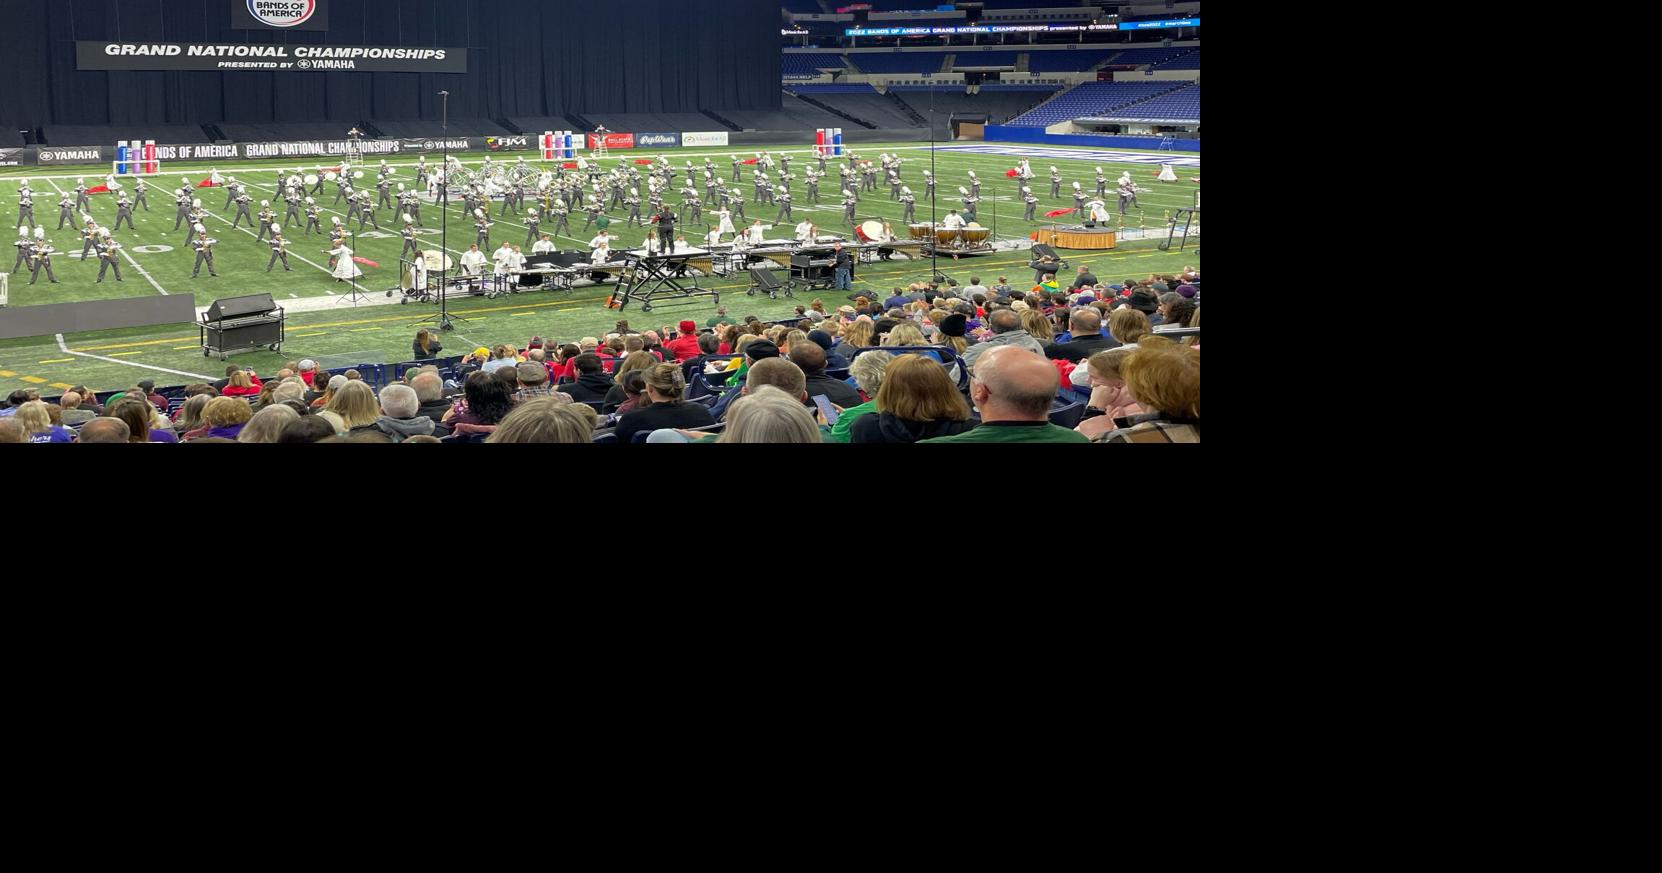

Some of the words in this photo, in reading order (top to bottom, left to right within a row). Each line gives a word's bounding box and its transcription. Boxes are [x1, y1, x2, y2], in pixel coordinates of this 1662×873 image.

[256, 2, 288, 10] BANDS
[260, 9, 302, 17] AMERICA
[105, 44, 181, 57] GRAND
[187, 45, 288, 58] NATIONAL
[294, 46, 446, 60] CHAMPIONSHIPS
[217, 61, 278, 69] PRESENTED
[311, 60, 355, 70] YAMAHA
[142, 146, 176, 159] BNDS
[179, 146, 192, 158] OF
[194, 145, 238, 158] AMERICA
[246, 144, 279, 156] GRAND
[281, 143, 325, 155] NATIONAL
[328, 141, 400, 154] CHAMIONSHIPS
[434, 141, 469, 149] YAMAHA
[54, 150, 100, 160] YAMAHA
